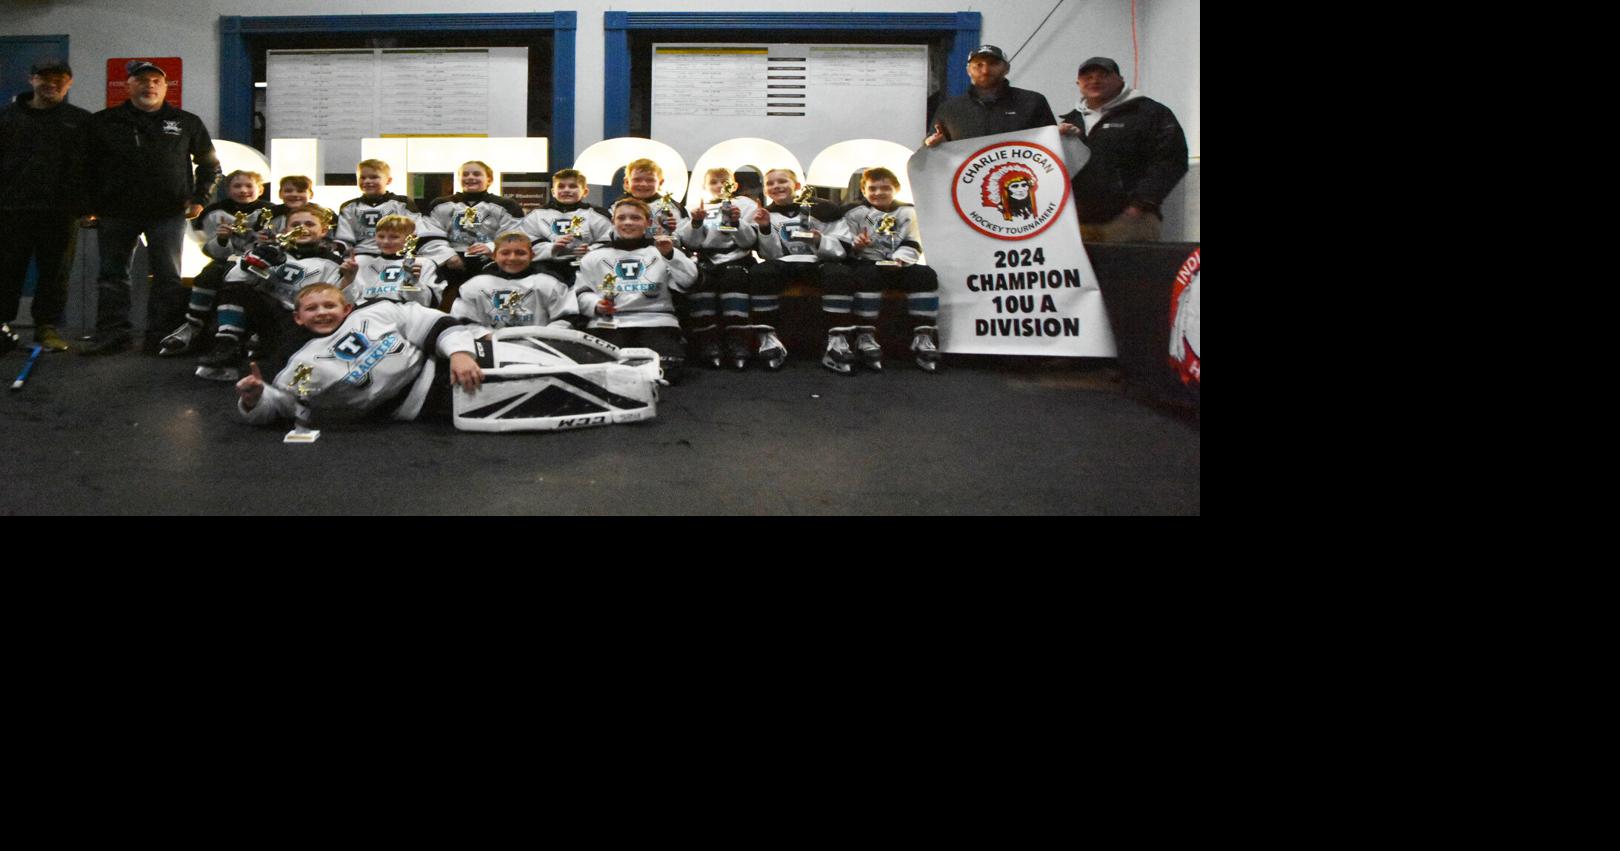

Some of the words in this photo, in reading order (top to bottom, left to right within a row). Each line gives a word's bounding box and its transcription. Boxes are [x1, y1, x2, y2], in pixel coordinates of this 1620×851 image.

[962, 150, 1008, 184] CHARLIE
[1012, 149, 1054, 174] HOGAN
[365, 213, 379, 225] T
[969, 211, 1005, 233] HOCKEY
[1005, 202, 1057, 235] TOURNAMENT
[994, 247, 1045, 268] 2024
[283, 267, 300, 281] T
[385, 267, 401, 280] T
[622, 262, 641, 276] T
[966, 269, 1081, 292] CHAMPION
[992, 295, 1034, 313] 10U
[1040, 294, 1057, 313] A
[975, 317, 1080, 337] DIVISION
[337, 335, 362, 354] T
[583, 334, 616, 352] CCM
[558, 416, 606, 428] CCM
